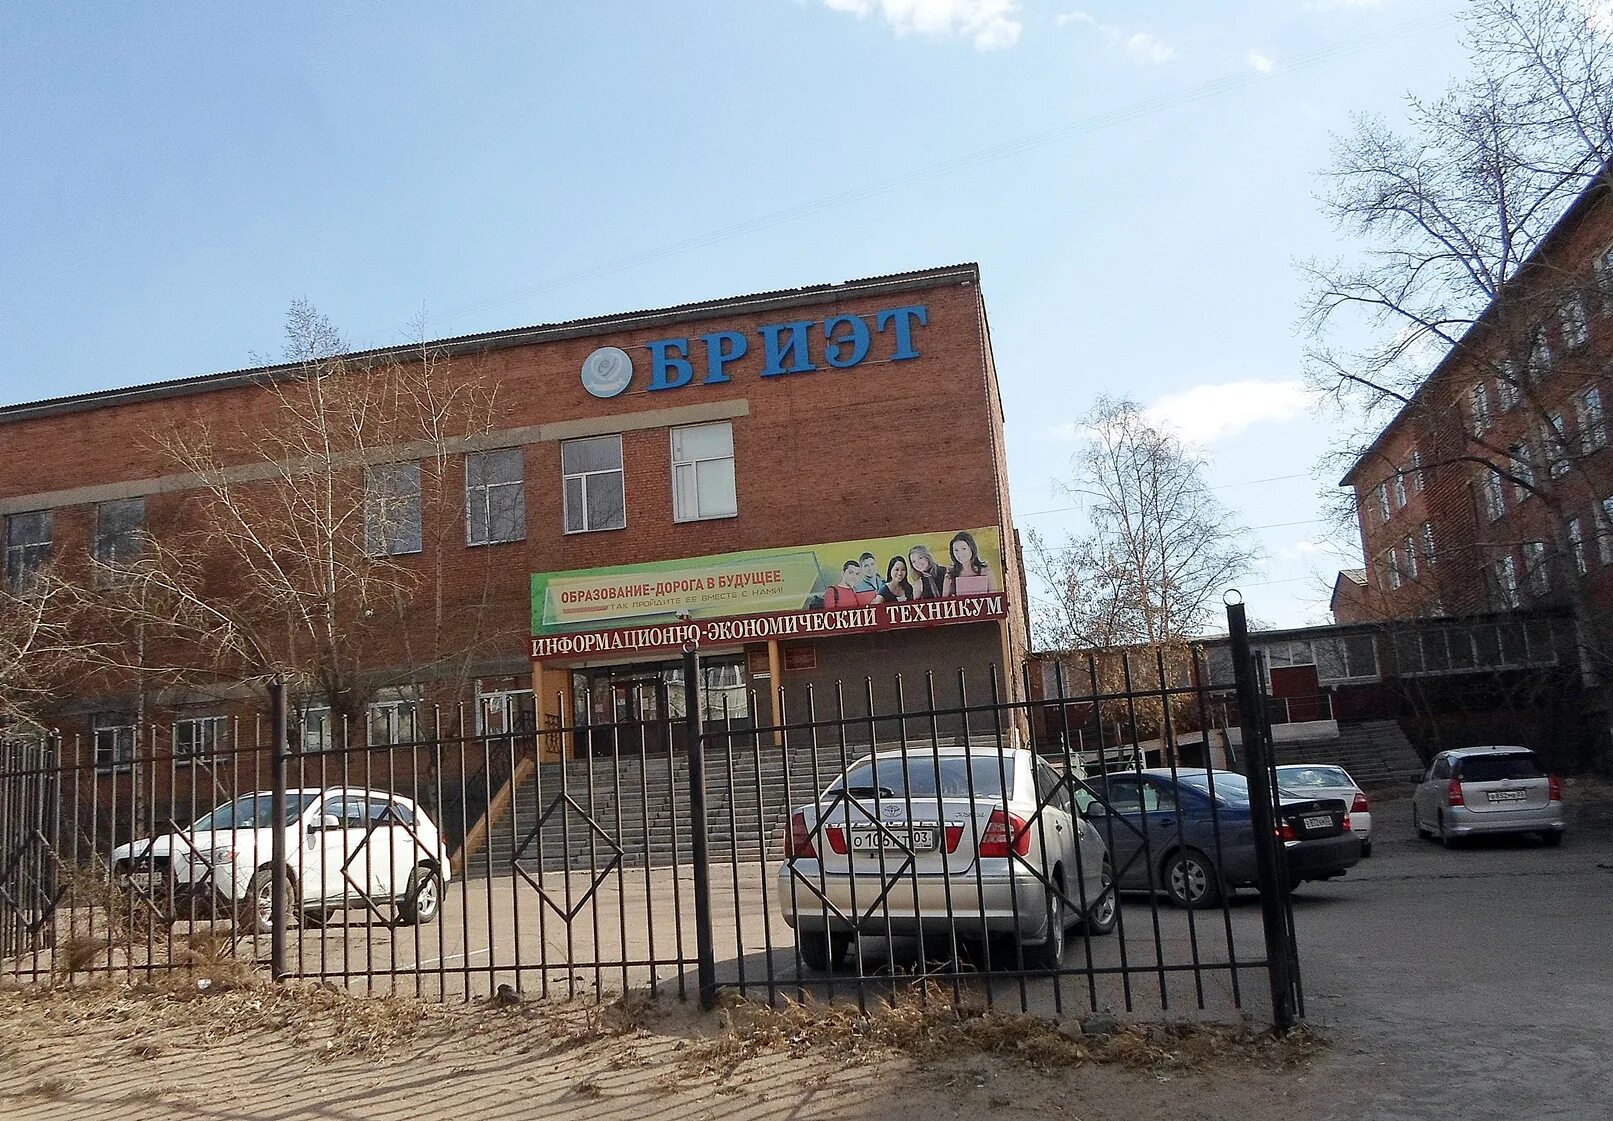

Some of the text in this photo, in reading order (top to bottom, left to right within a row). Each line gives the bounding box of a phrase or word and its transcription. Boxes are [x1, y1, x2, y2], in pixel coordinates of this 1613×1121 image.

[645, 304, 928, 392] БРИЭТ
[561, 570, 785, 604] ОБРАЗОВАНИЕ-ДОРОГА В БУДУЩЕЕ.
[632, 597, 681, 608] ПРОЙДИТЕ
[702, 592, 737, 602] ВМЕСТЕ
[741, 590, 748, 598] С
[752, 587, 783, 596] НАМИ!
[531, 604, 877, 657] ИНФОРМАЦИОННО-ЭКОНОМИЧЕСКИЙ
[886, 596, 1003, 624] ТЕХНИКУМ
[913, 831, 928, 843] 03
